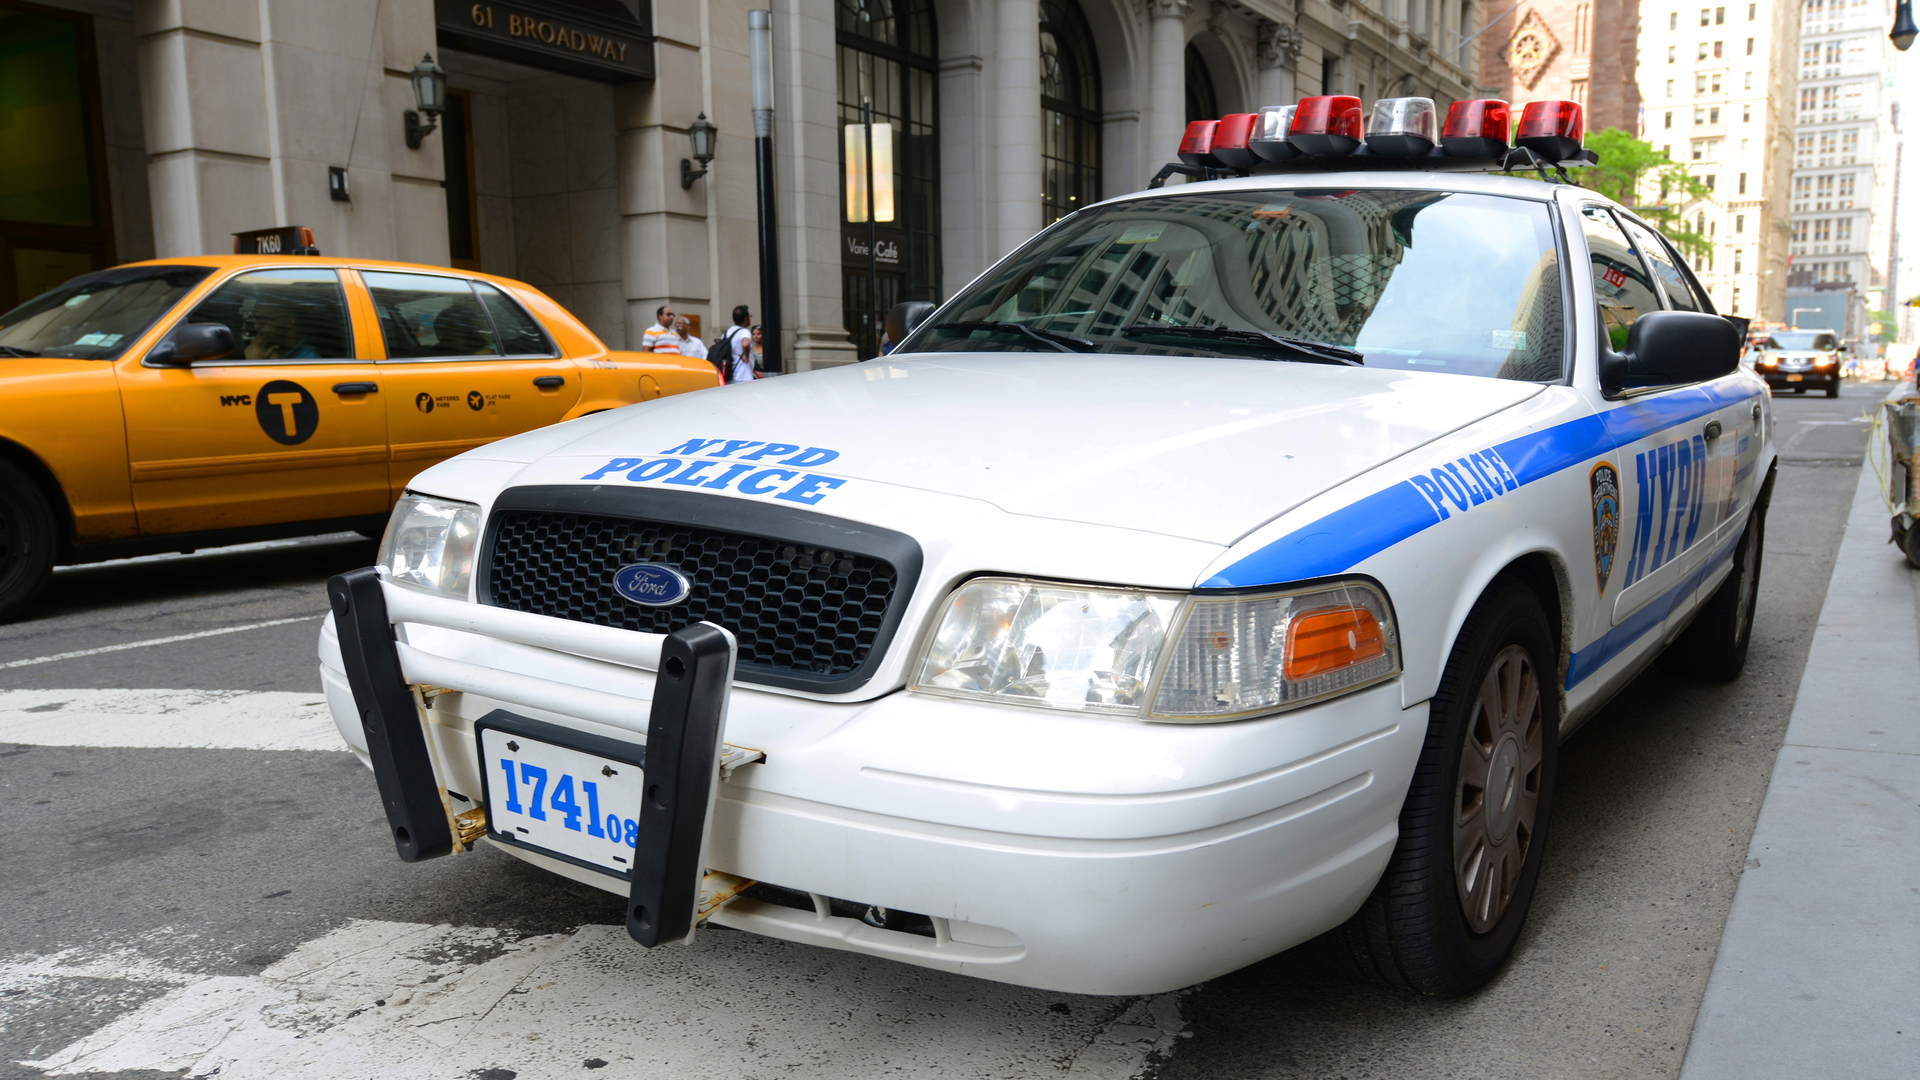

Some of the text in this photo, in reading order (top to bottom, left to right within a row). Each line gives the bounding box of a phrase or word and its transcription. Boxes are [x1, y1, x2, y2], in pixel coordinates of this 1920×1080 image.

[471, 4, 627, 62] 61 BROADWAY
[256, 234, 281, 254] 7K60
[220, 395, 252, 407] NYC
[658, 438, 840, 467] NYPD
[580, 457, 848, 506] POLICE
[1409, 448, 1518, 521] POLICE
[1595, 467, 1613, 486] POLICE
[1623, 434, 1706, 590] NYPD
[628, 571, 669, 596] Ford
[500, 758, 639, 849] 1741 08
